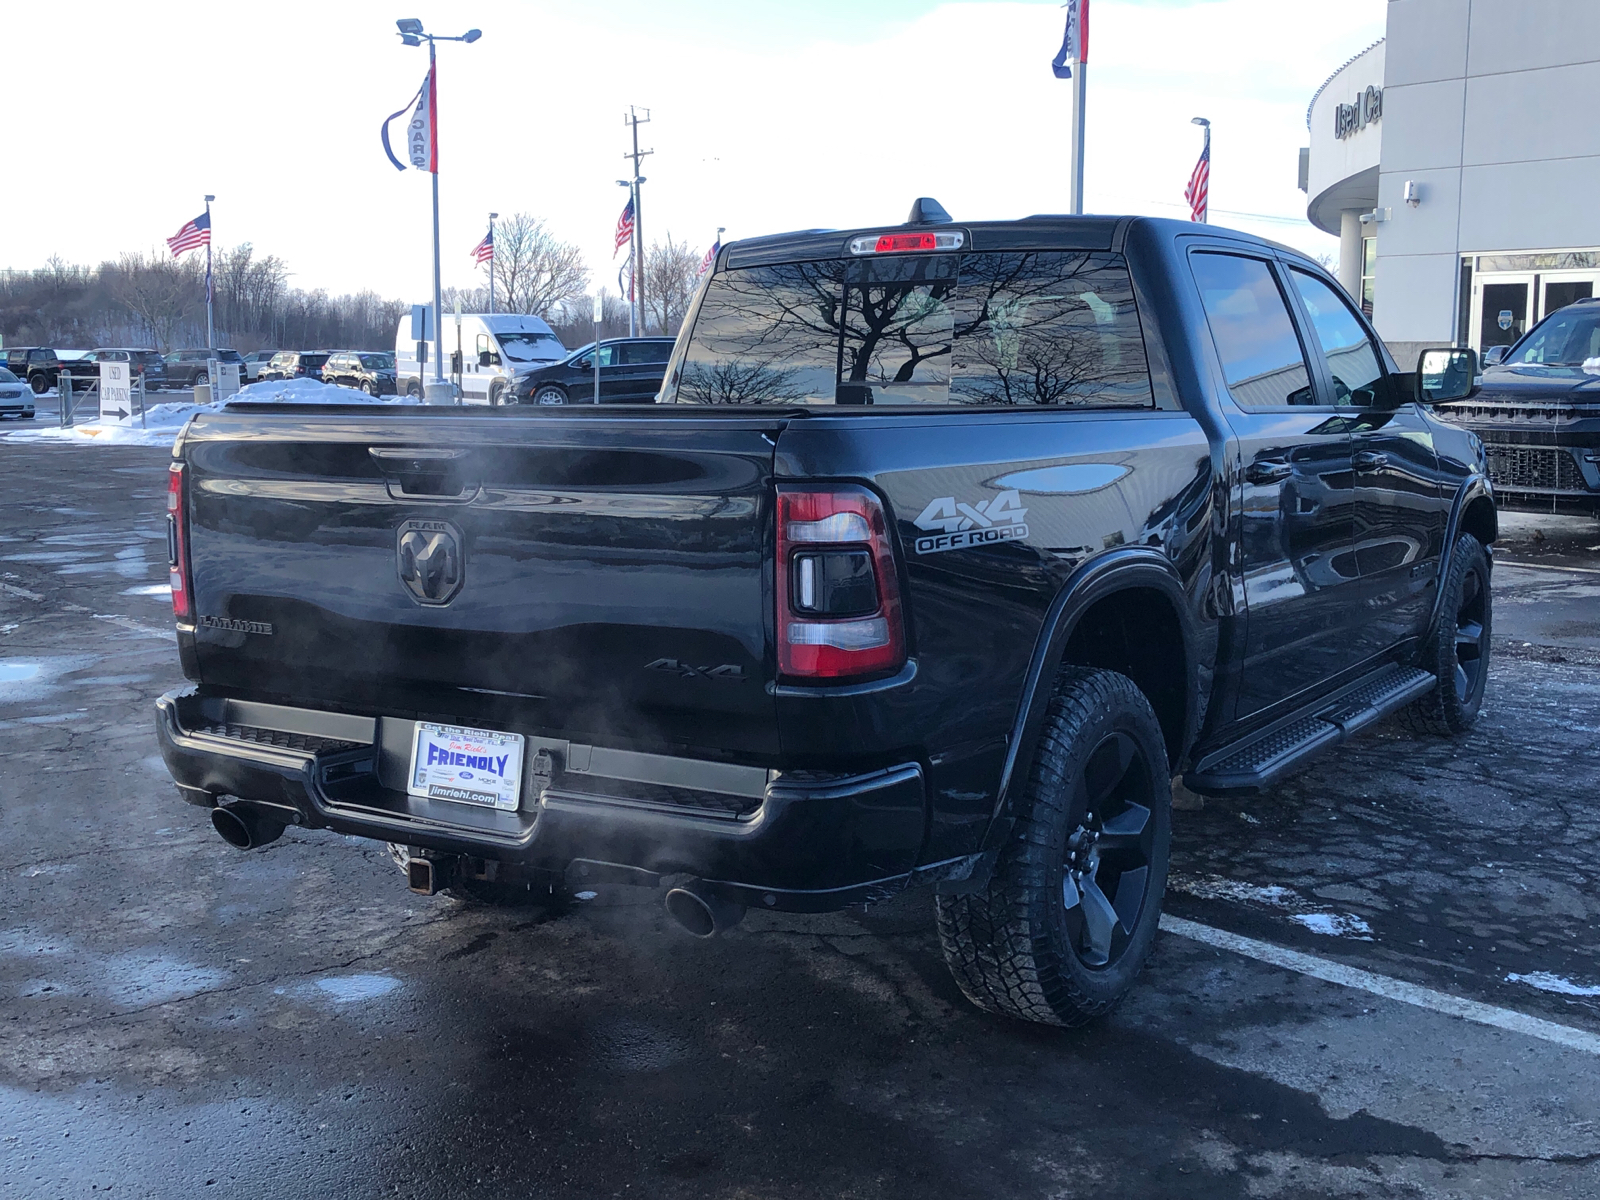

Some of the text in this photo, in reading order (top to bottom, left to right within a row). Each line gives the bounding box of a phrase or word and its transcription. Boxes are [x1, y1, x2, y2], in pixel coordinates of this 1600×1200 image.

[1335, 92, 1364, 140] Used
[408, 521, 447, 530] RAM
[918, 525, 1027, 552] OFF ROAD
[424, 724, 515, 741] Get the Riehl Deal
[448, 742, 487, 754] Jim Riehl's
[427, 742, 509, 778] FRIENDLY
[430, 785, 495, 804] jimriehl.com
